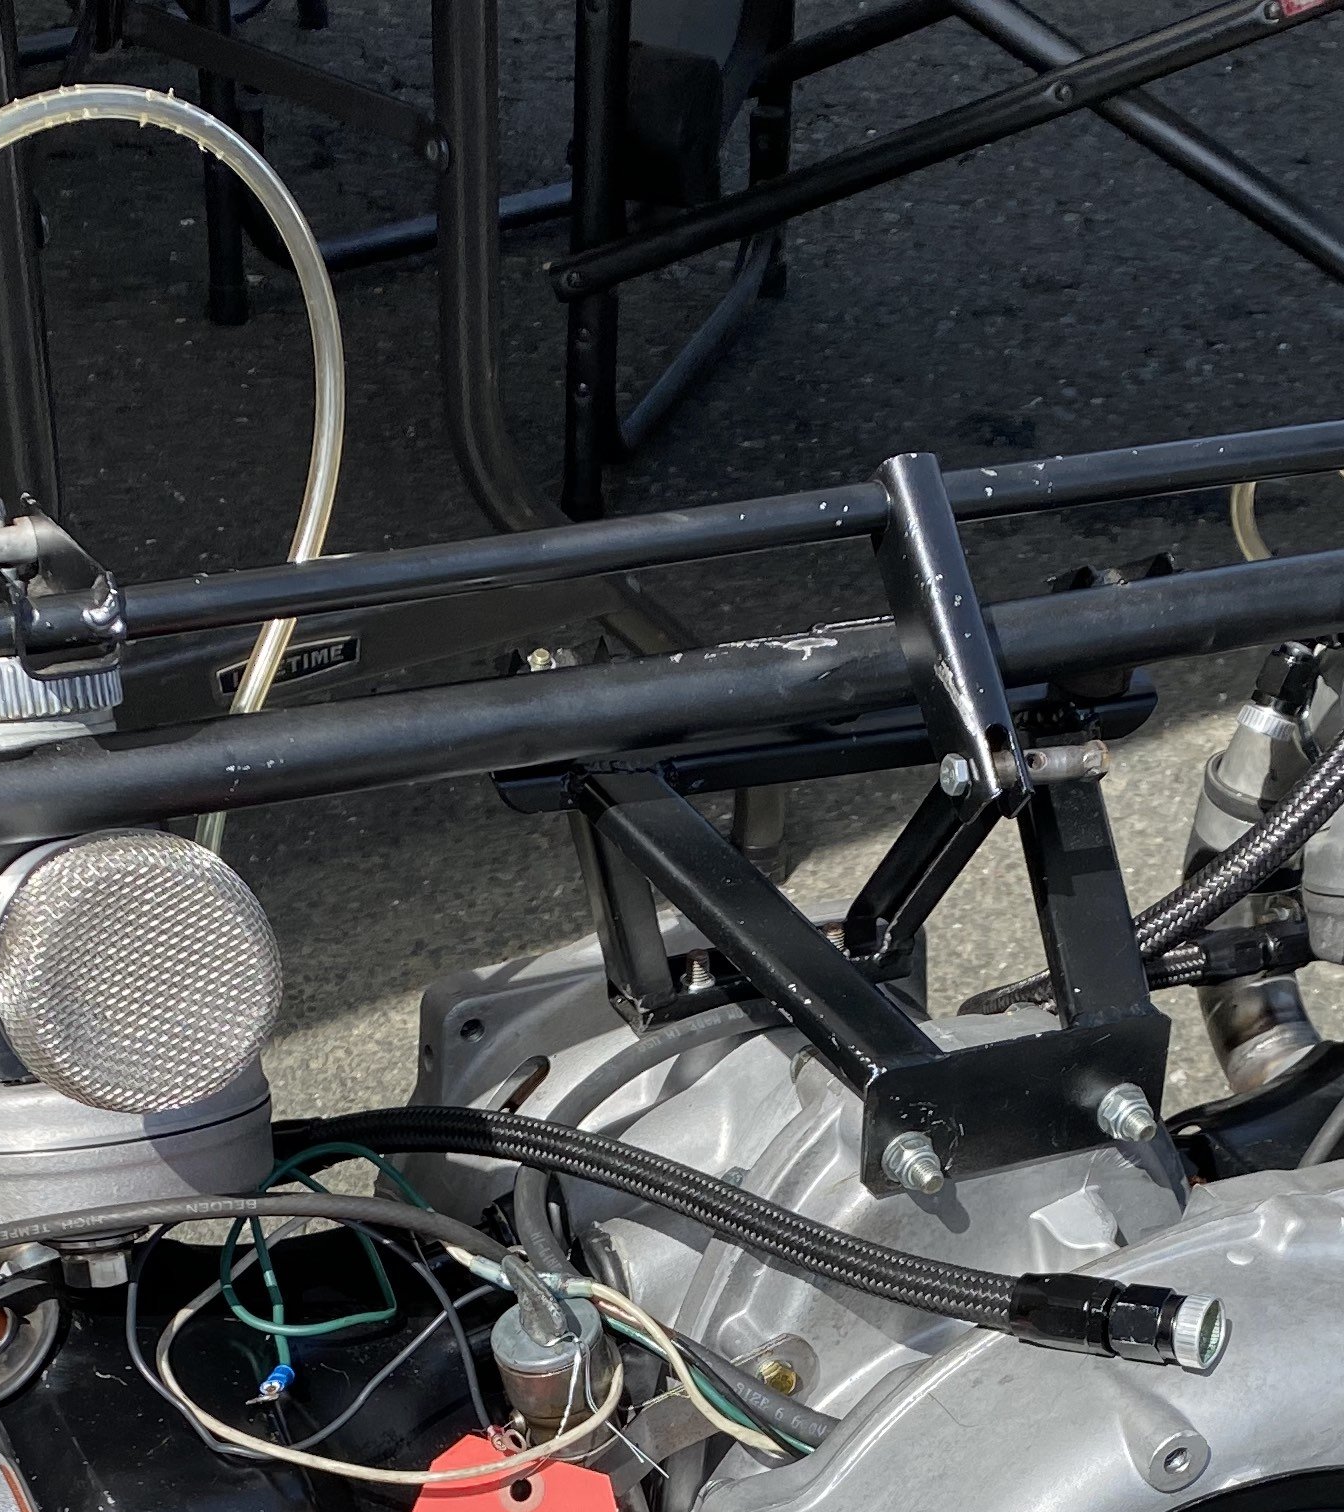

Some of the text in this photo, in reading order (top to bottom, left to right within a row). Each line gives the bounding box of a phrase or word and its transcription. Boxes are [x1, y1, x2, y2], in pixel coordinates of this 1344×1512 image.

[185, 1199, 257, 1214] BELDEN
[60, 1214, 106, 1231] HIGH
[774, 1406, 785, 1421] 6
